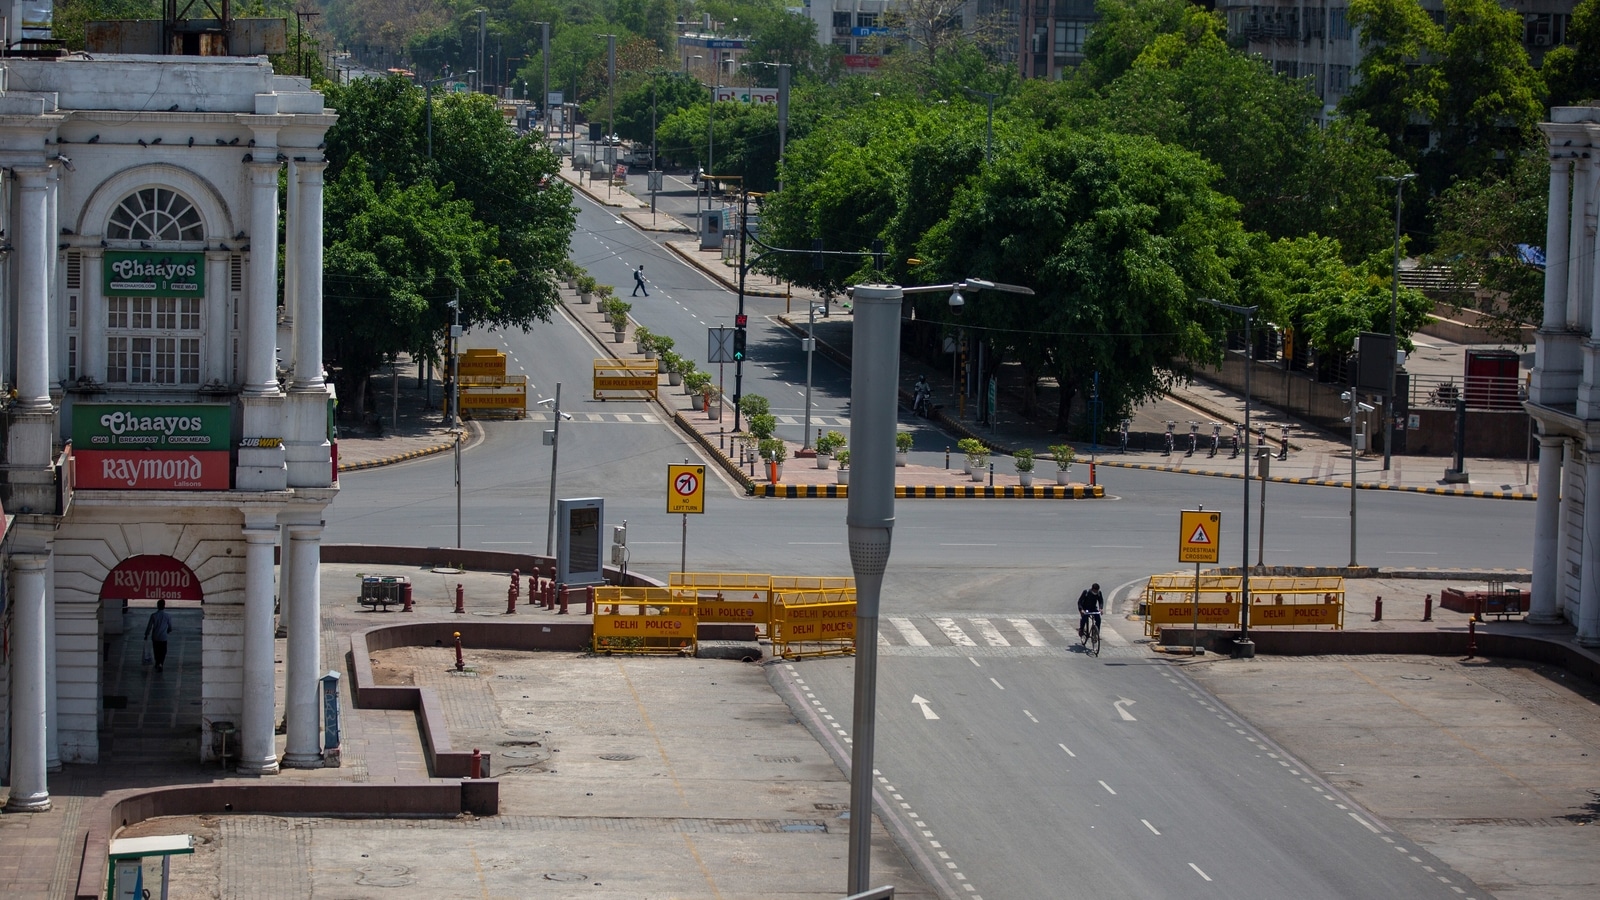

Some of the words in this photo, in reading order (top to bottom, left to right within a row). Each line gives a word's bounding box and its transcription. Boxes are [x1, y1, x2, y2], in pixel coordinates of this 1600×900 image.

[112, 259, 196, 280] Chaayos
[101, 411, 202, 435] Chaayos
[239, 438, 284, 447] SUBWAY
[145, 588, 182, 599] Lallsons
[719, 608, 745, 617] POLICE
[793, 610, 818, 618] DELHI
[822, 610, 849, 618] POLICE
[1169, 608, 1192, 616] DELHI
[1197, 608, 1222, 616] POLICE
[1263, 610, 1286, 618] DELHI
[1294, 609, 1319, 617] POLICE
[614, 620, 638, 629] DELHI
[646, 620, 673, 629] POLICE
[793, 624, 814, 634] DELHI
[822, 622, 846, 632] POLICE
